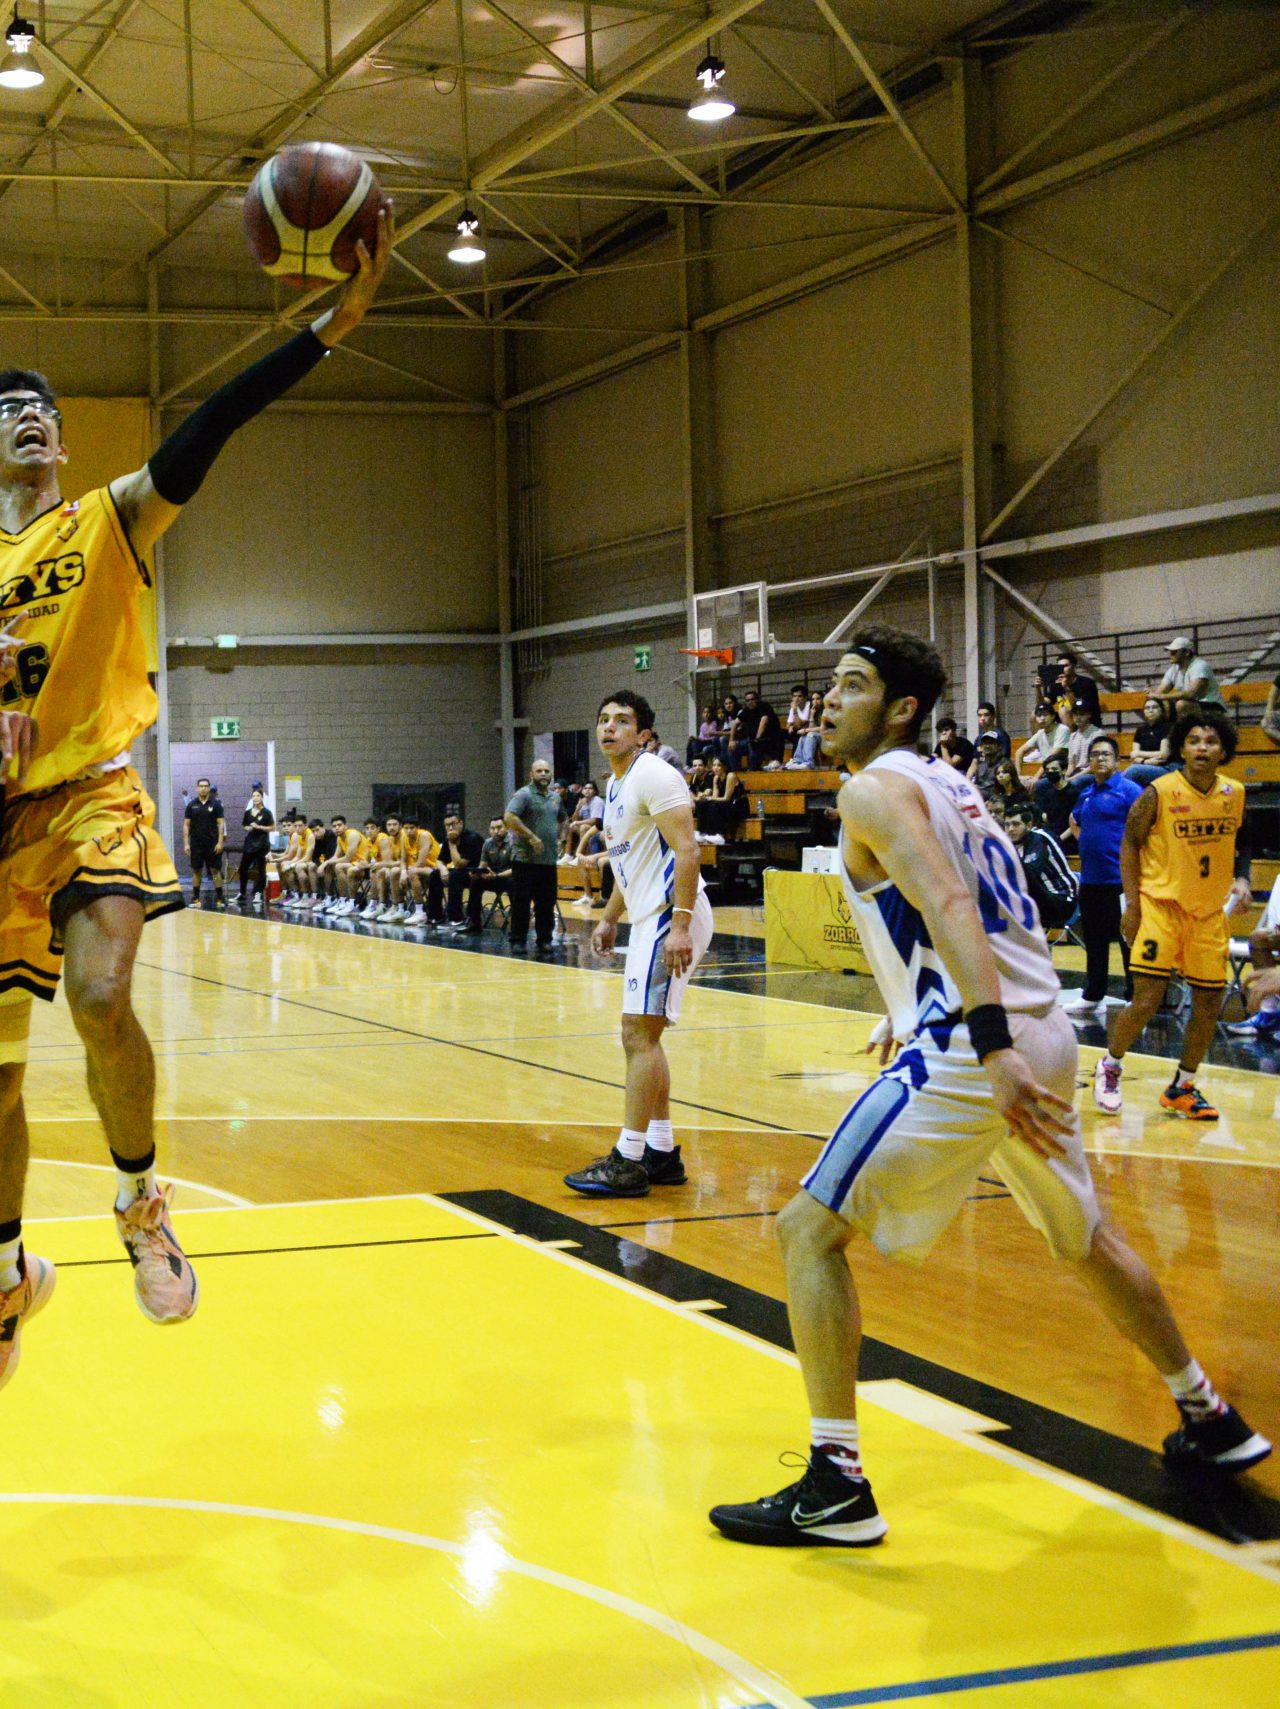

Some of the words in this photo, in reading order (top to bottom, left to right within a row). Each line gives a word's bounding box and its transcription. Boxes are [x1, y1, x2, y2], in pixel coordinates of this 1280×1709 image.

[1173, 817, 1237, 839] CETYS
[1200, 854, 1211, 878] 3
[963, 831, 1035, 934] 10
[823, 925, 862, 945] ZORRO
[1141, 939, 1159, 962] 3
